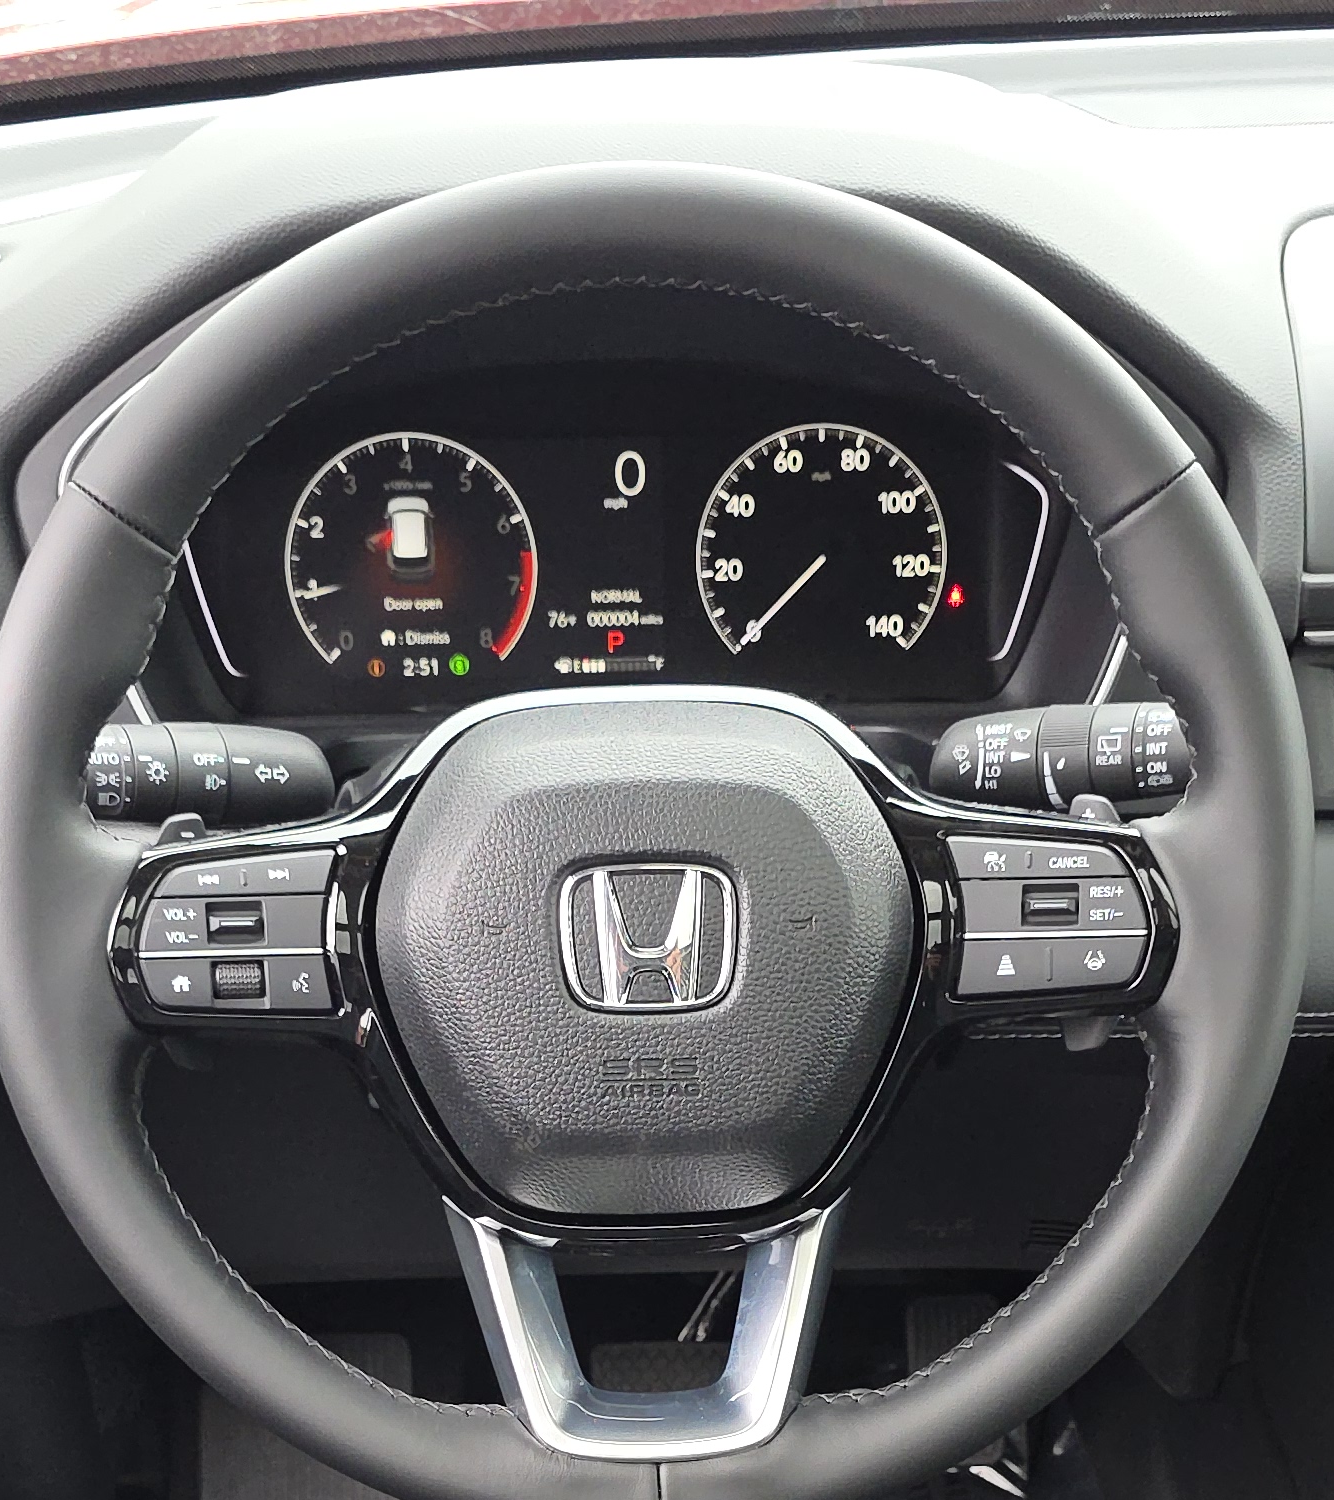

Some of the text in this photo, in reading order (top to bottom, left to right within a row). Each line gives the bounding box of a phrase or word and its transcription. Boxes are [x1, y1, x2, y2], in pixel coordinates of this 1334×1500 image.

[399, 454, 413, 473] 4
[774, 449, 803, 473] 60
[841, 448, 871, 472] 80
[615, 450, 645, 496] 0
[344, 475, 357, 495] 3
[459, 473, 472, 493] 5
[725, 494, 755, 517] 40
[878, 490, 916, 514] 100
[309, 516, 325, 539] 2
[497, 515, 511, 534] 6
[714, 558, 743, 581] 20
[892, 554, 930, 577] 120
[384, 596, 443, 612] Door open
[591, 588, 643, 604] NORMAL
[866, 614, 904, 637] 140
[339, 630, 354, 650] 0
[405, 629, 450, 645] Dismiss
[479, 627, 493, 649] 8
[608, 630, 625, 653] P
[403, 657, 438, 676] 2:51
[1147, 724, 1173, 736] OFF
[985, 738, 1009, 750] OFF
[1146, 742, 1168, 755] INT
[193, 753, 217, 766] OFF
[986, 750, 1005, 763] INT
[1095, 754, 1122, 765] REAR
[985, 765, 1001, 778] LO
[1147, 761, 1167, 773] ON
[984, 780, 998, 790] HI
[1048, 856, 1089, 869] CANCEL
[1089, 886, 1124, 899] RES/+
[163, 907, 197, 921] VOL+
[602, 1057, 700, 1079] SRS
[602, 1083, 702, 1098] AIRBAG
